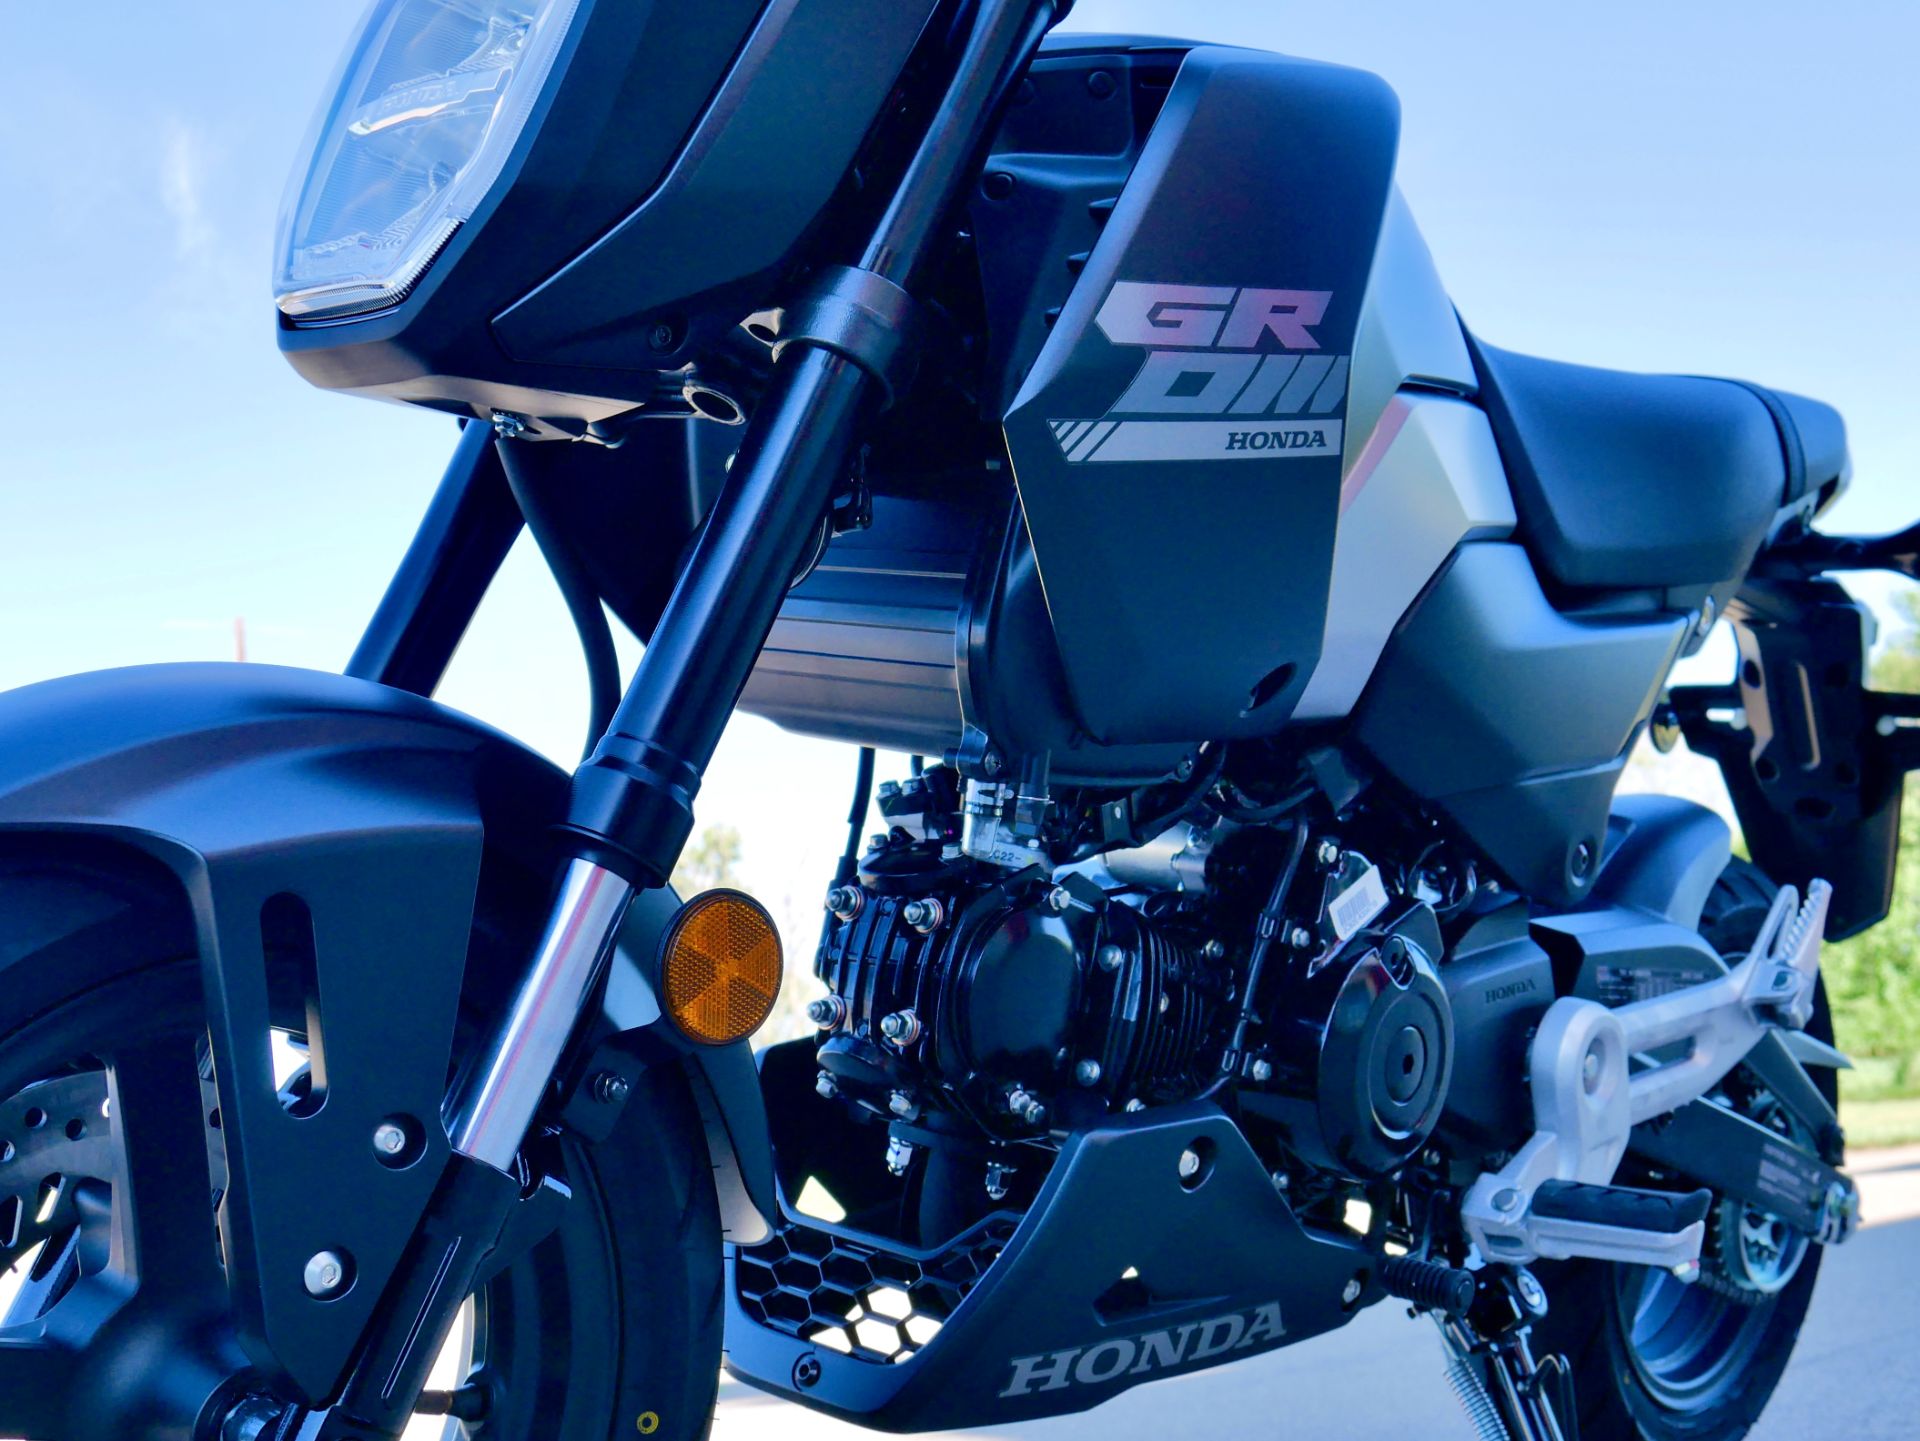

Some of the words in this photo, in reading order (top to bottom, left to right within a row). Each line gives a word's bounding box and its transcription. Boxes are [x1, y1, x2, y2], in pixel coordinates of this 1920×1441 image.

[1095, 280, 1334, 349] GR
[1225, 431, 1327, 450] HONDA
[1485, 979, 1537, 1004] HONDA
[999, 1301, 1287, 1398] HONDA
